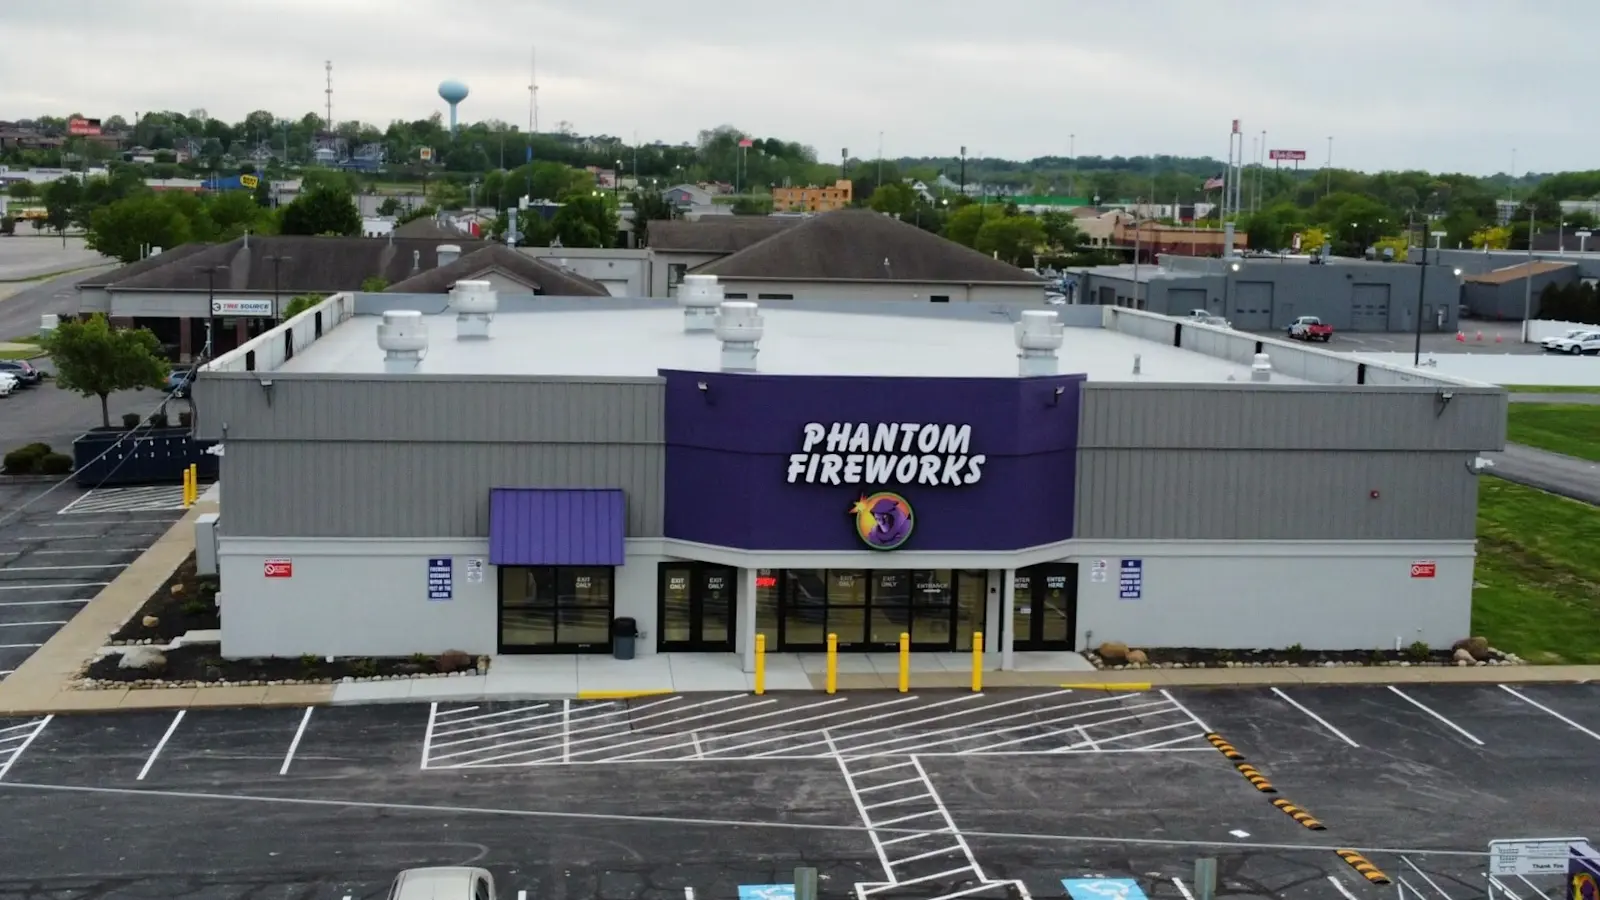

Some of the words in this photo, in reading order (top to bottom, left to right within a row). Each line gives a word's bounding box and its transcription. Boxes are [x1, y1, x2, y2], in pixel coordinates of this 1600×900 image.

[803, 422, 972, 454] PHANTOM
[787, 453, 986, 486] FIREWORKS
[838, 580, 855, 588] ONLY
